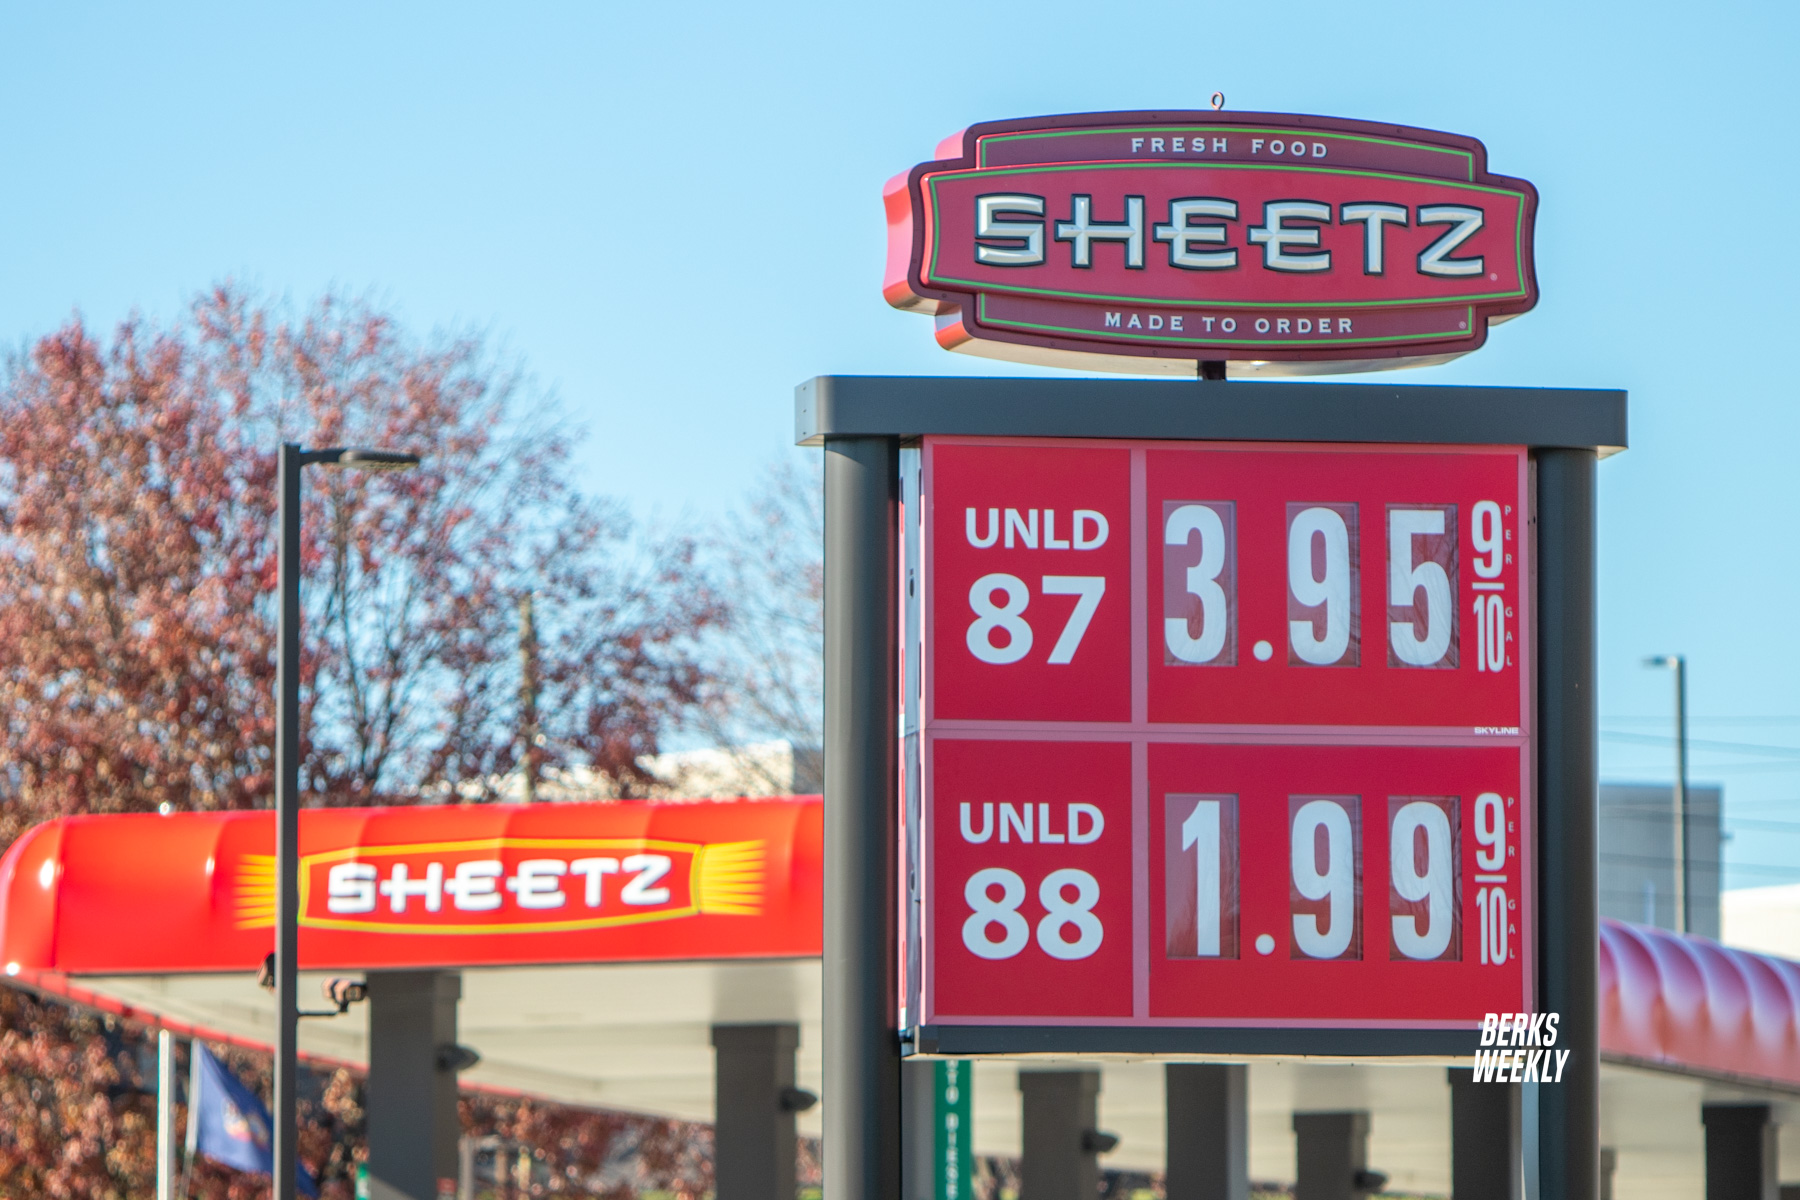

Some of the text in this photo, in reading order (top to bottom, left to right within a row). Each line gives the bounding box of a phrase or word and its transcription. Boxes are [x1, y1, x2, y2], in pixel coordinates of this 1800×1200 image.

[1131, 136, 1329, 159] FRESH FOOD
[974, 192, 1485, 279] SHEETZ
[1104, 311, 1354, 334] MADE TO ORDER
[965, 506, 1110, 551] UNLD
[1163, 503, 1453, 666] 3.95
[965, 572, 1106, 665] 87
[1473, 726, 1520, 736] SKYLINE
[959, 801, 1105, 845] UNLD
[327, 854, 673, 915] SHEETZ
[1181, 799, 1453, 961] 1.99
[961, 867, 1104, 960] 88
